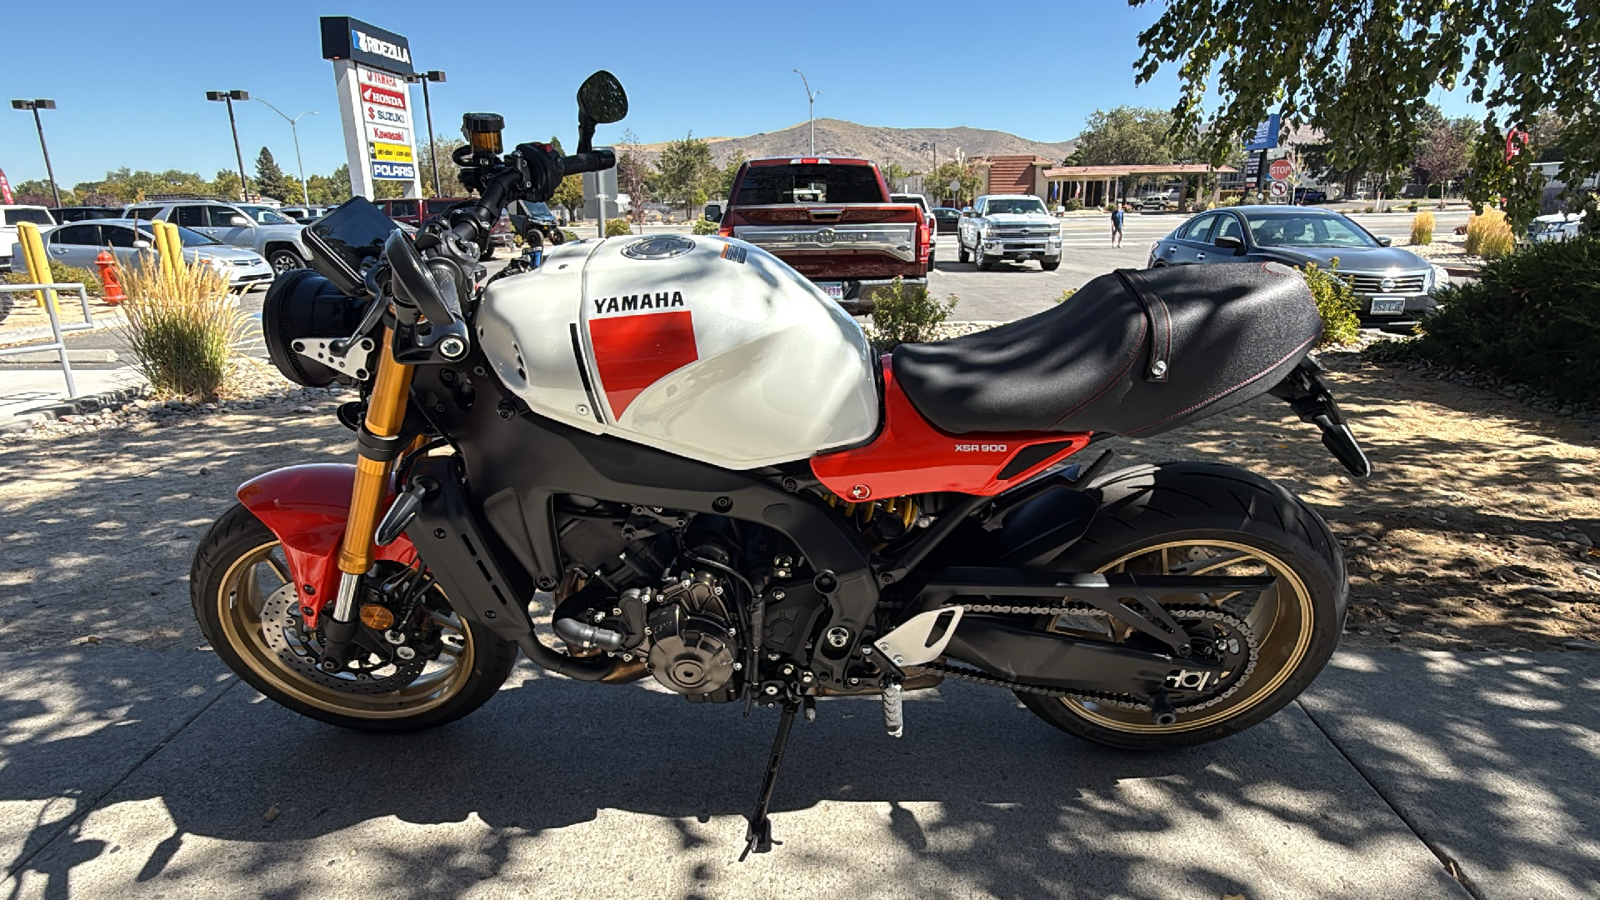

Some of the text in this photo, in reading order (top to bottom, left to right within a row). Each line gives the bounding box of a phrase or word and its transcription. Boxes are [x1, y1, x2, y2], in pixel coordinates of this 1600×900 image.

[366, 36, 410, 64] RIDEZILLA
[373, 72, 398, 88] YAMAHA
[372, 92, 404, 108] HONDA
[377, 110, 405, 124] SUZUKI
[373, 127, 404, 142] Kawasaki
[373, 164, 414, 178] POLARIS
[1271, 166, 1291, 175] STOP
[594, 291, 684, 314] YAMAHA
[954, 444, 1007, 452] XSR 900
